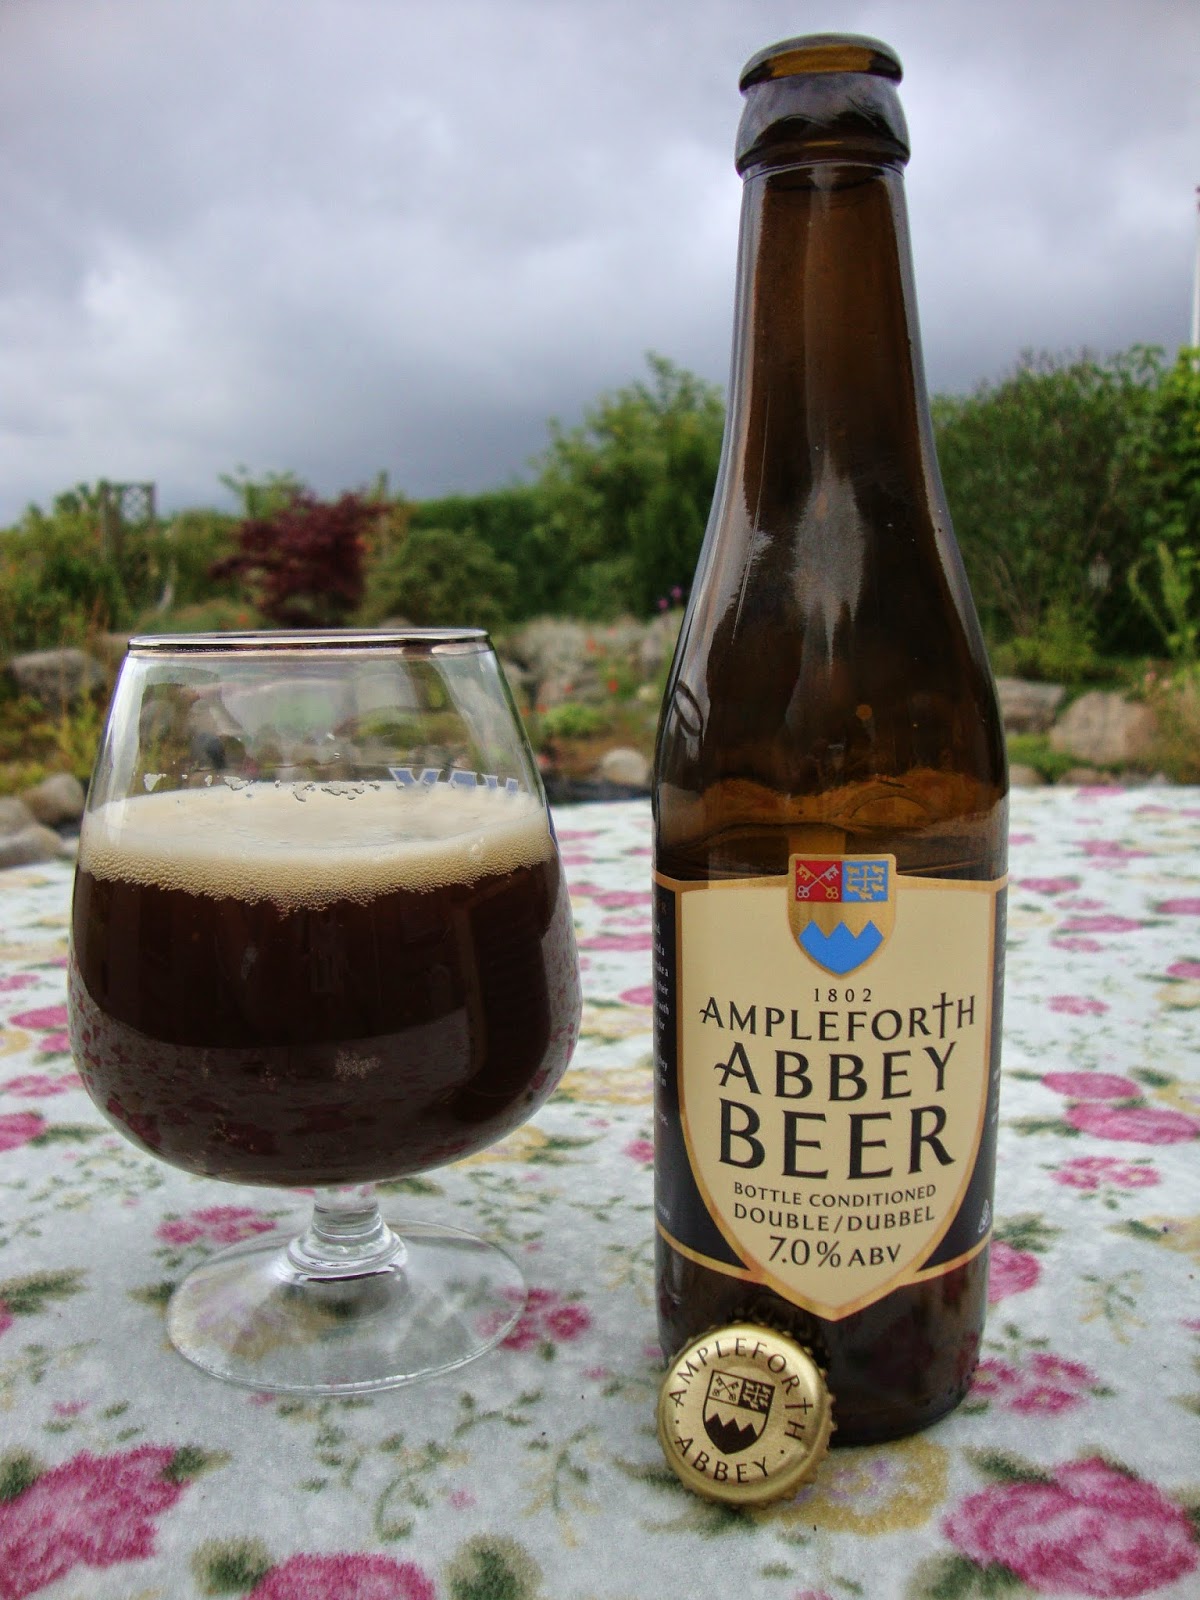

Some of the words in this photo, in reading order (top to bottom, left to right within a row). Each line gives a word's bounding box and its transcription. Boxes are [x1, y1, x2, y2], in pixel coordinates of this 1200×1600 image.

[698, 992, 976, 1042] AMPLEFORTH
[814, 988, 872, 1002] 1802
[713, 1041, 958, 1102] ABBEY
[718, 1097, 956, 1180] BEER
[733, 1181, 802, 1206] BOTTLE
[809, 1184, 936, 1208] CONDITIONED
[733, 1203, 936, 1234] DOUBLE/DUBBEL
[768, 1235, 841, 1268] 7.0%
[847, 1244, 901, 1267] ABV
[669, 1338, 814, 1441] AMPLEFORTH
[674, 1436, 769, 1483] ABBEY
